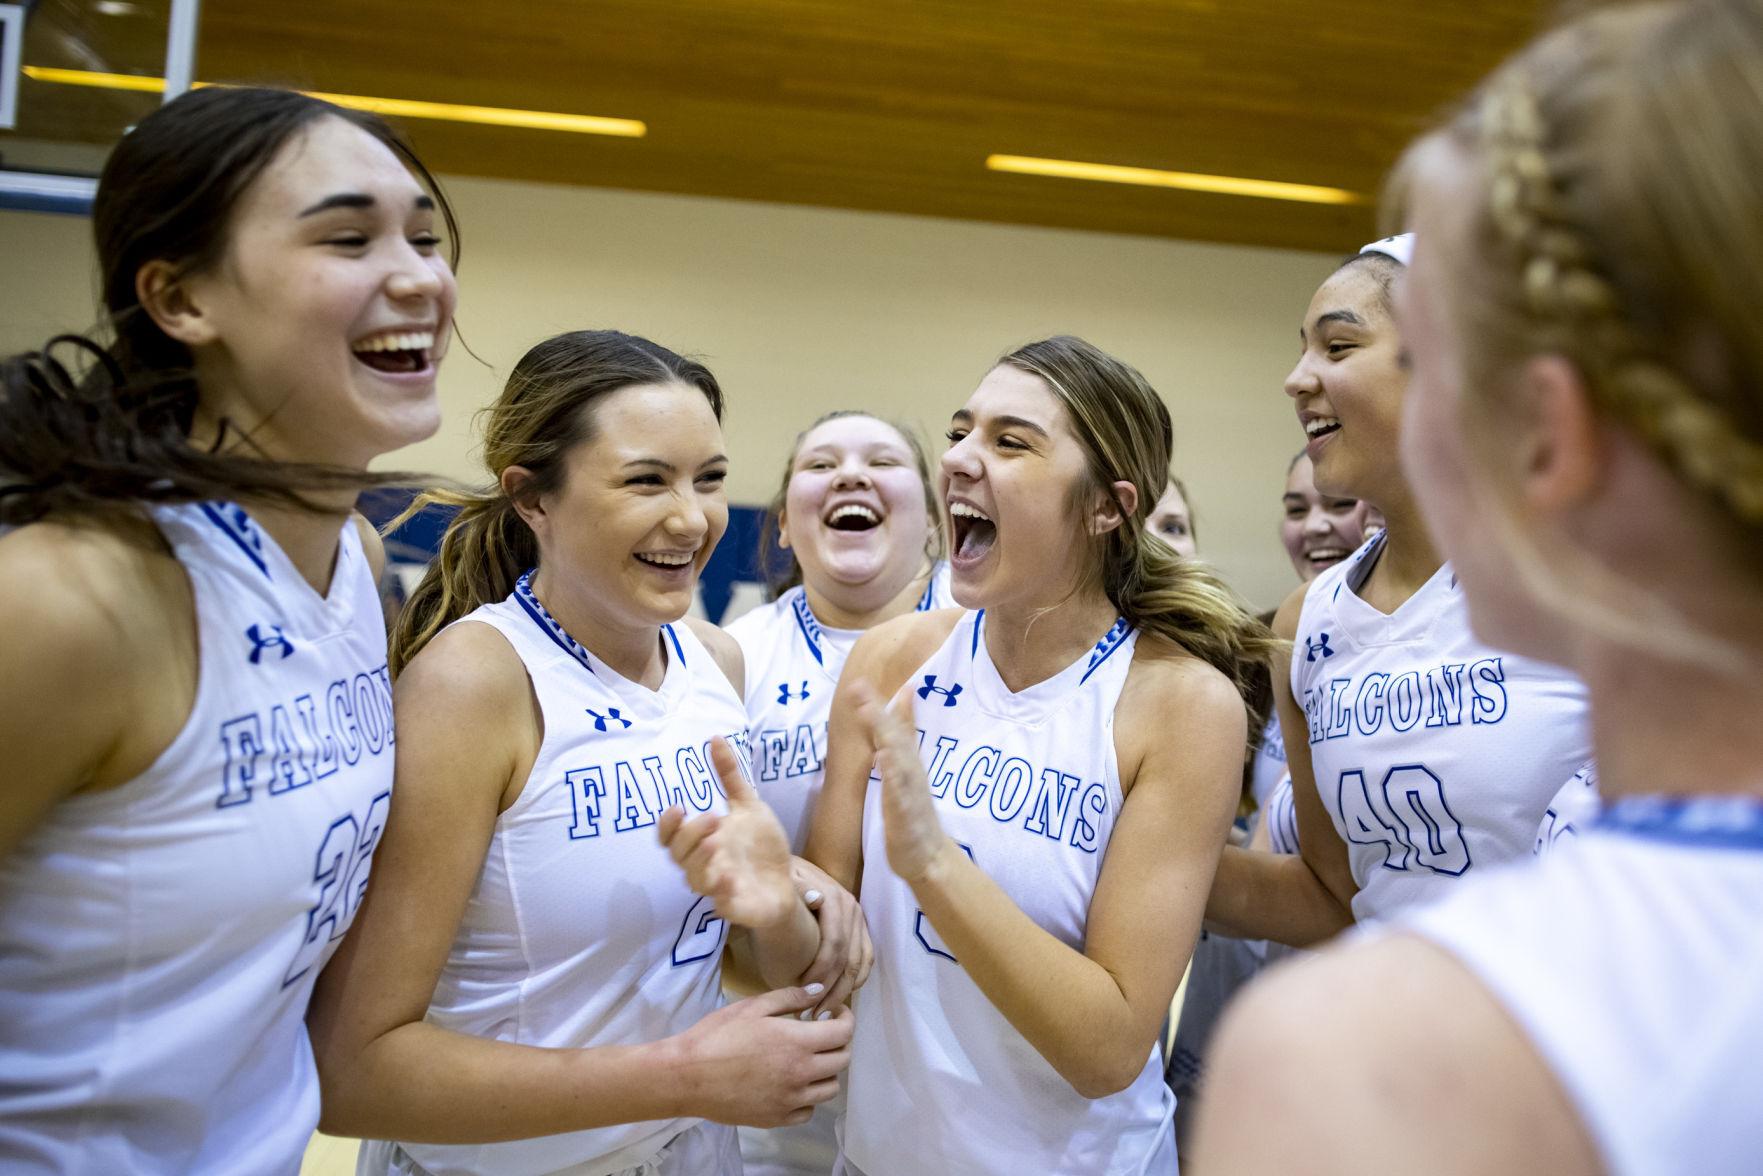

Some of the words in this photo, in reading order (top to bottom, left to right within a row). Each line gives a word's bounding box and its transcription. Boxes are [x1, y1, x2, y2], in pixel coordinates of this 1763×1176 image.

[760, 723, 828, 782] FA
[868, 727, 1107, 854] LCONS
[1338, 765, 1473, 877] 40
